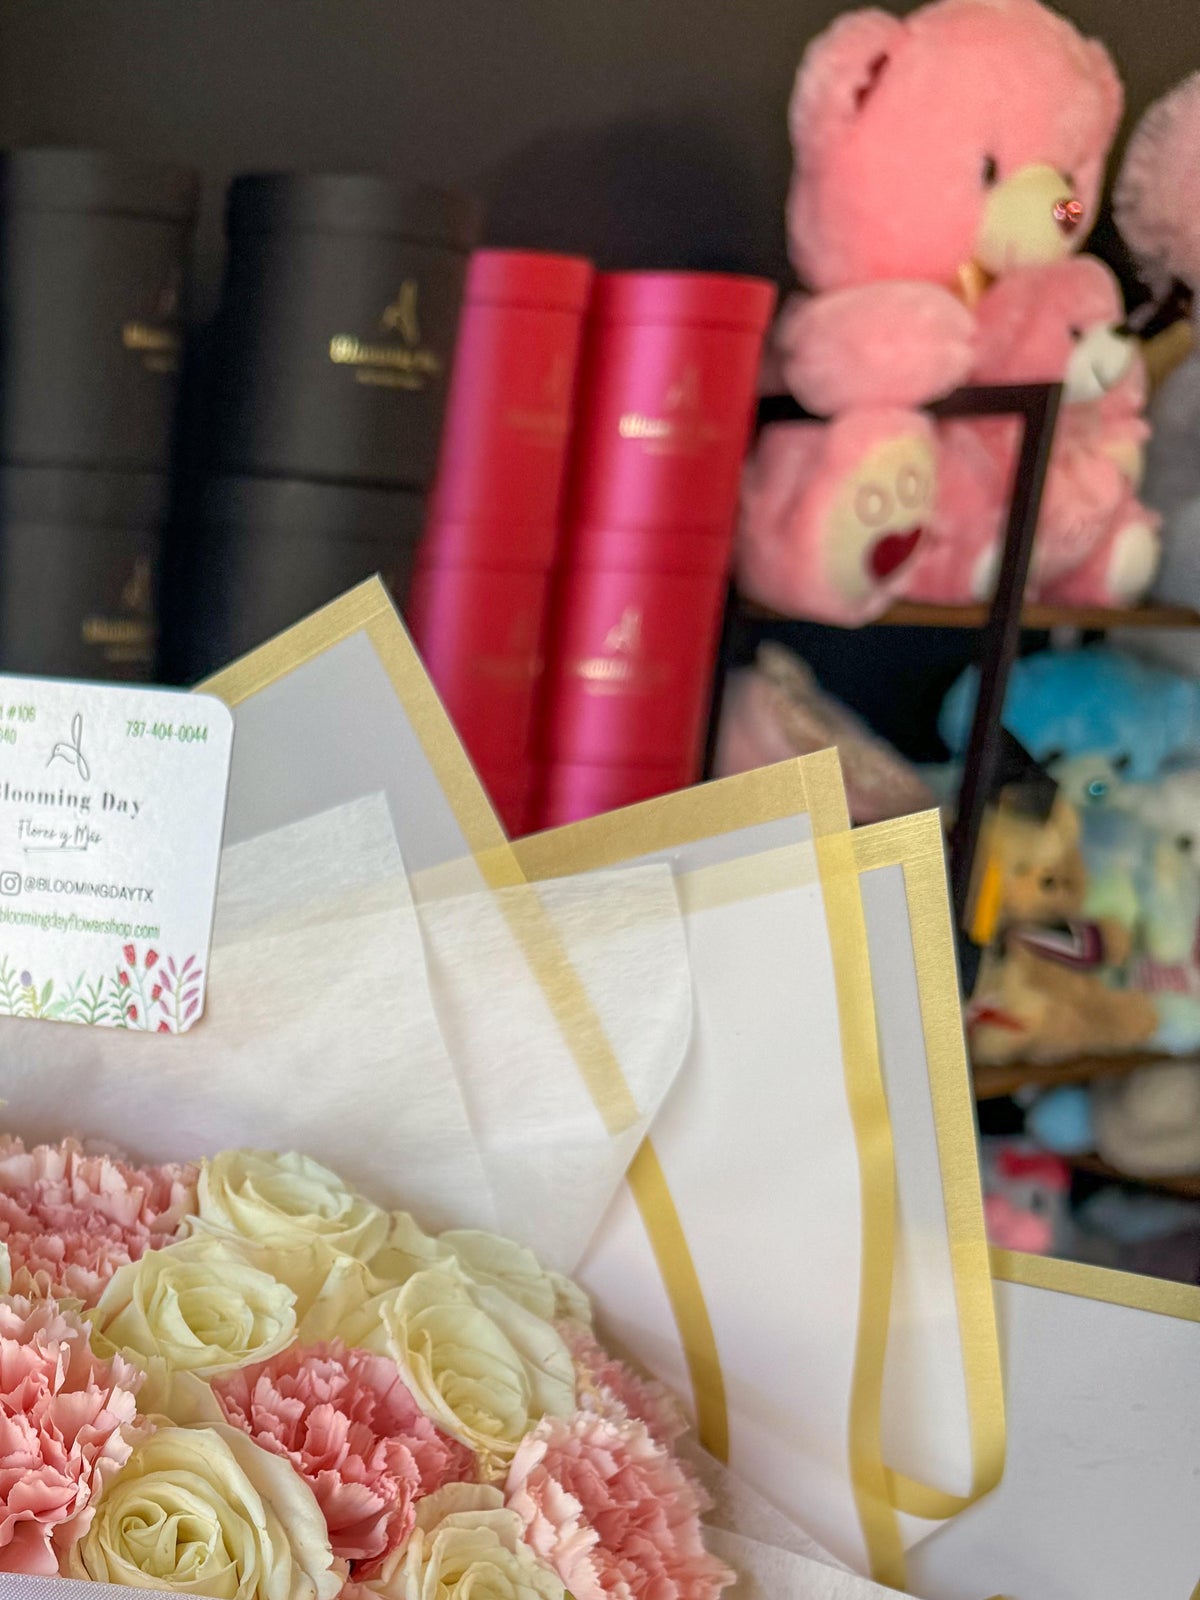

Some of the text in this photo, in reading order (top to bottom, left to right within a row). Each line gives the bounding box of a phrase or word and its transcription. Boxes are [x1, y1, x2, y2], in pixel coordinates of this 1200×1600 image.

[102, 792, 142, 819] Day
[18, 819, 56, 840] Flores
[24, 876, 154, 902] @BLOOMINGDAYTX
